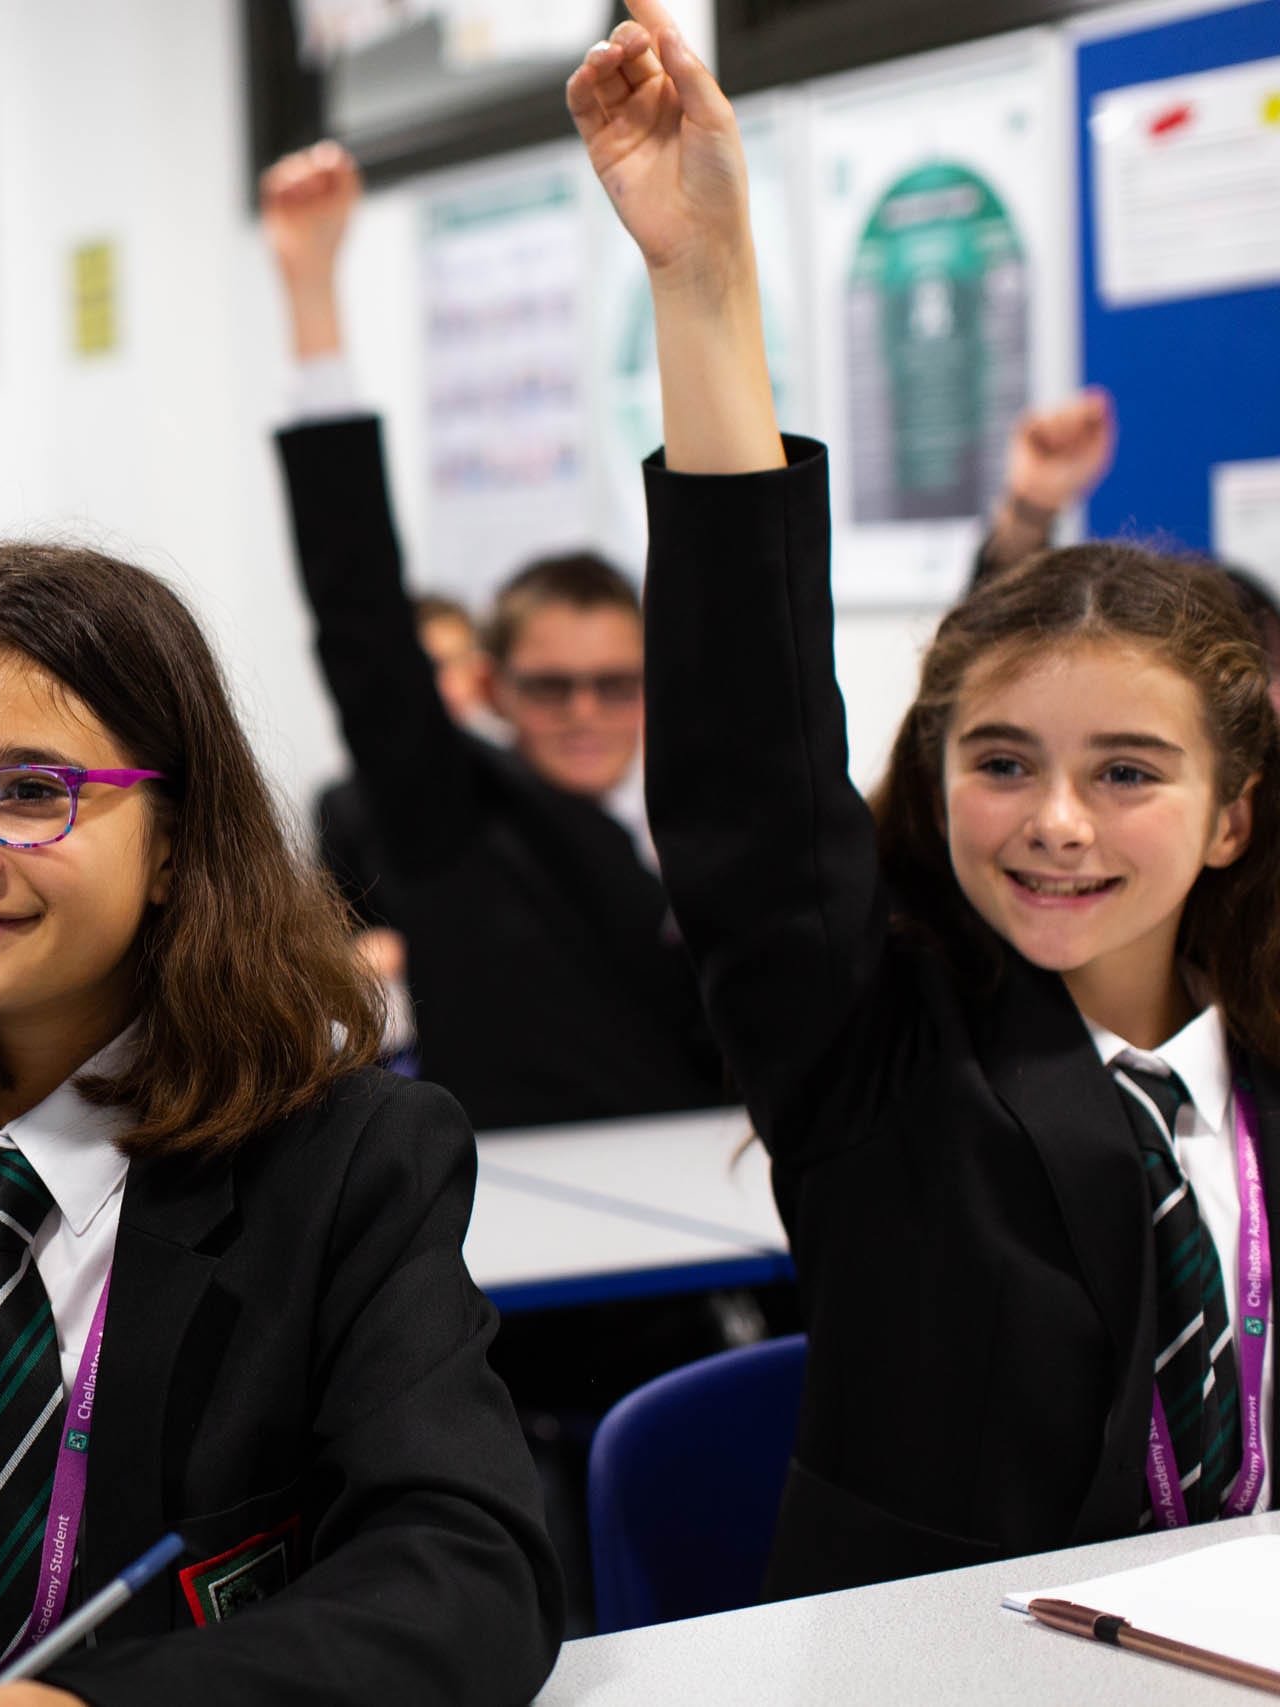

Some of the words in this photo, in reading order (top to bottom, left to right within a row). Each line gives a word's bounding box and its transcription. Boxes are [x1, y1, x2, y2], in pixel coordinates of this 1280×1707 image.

[1247, 1182, 1263, 1239] Academy
[1247, 1239, 1262, 1308] Chellaston
[1151, 1443, 1174, 1507] Academy
[1234, 1450, 1261, 1512] Academy
[31, 1575, 62, 1643] Academy
[49, 1513, 70, 1574] Student
